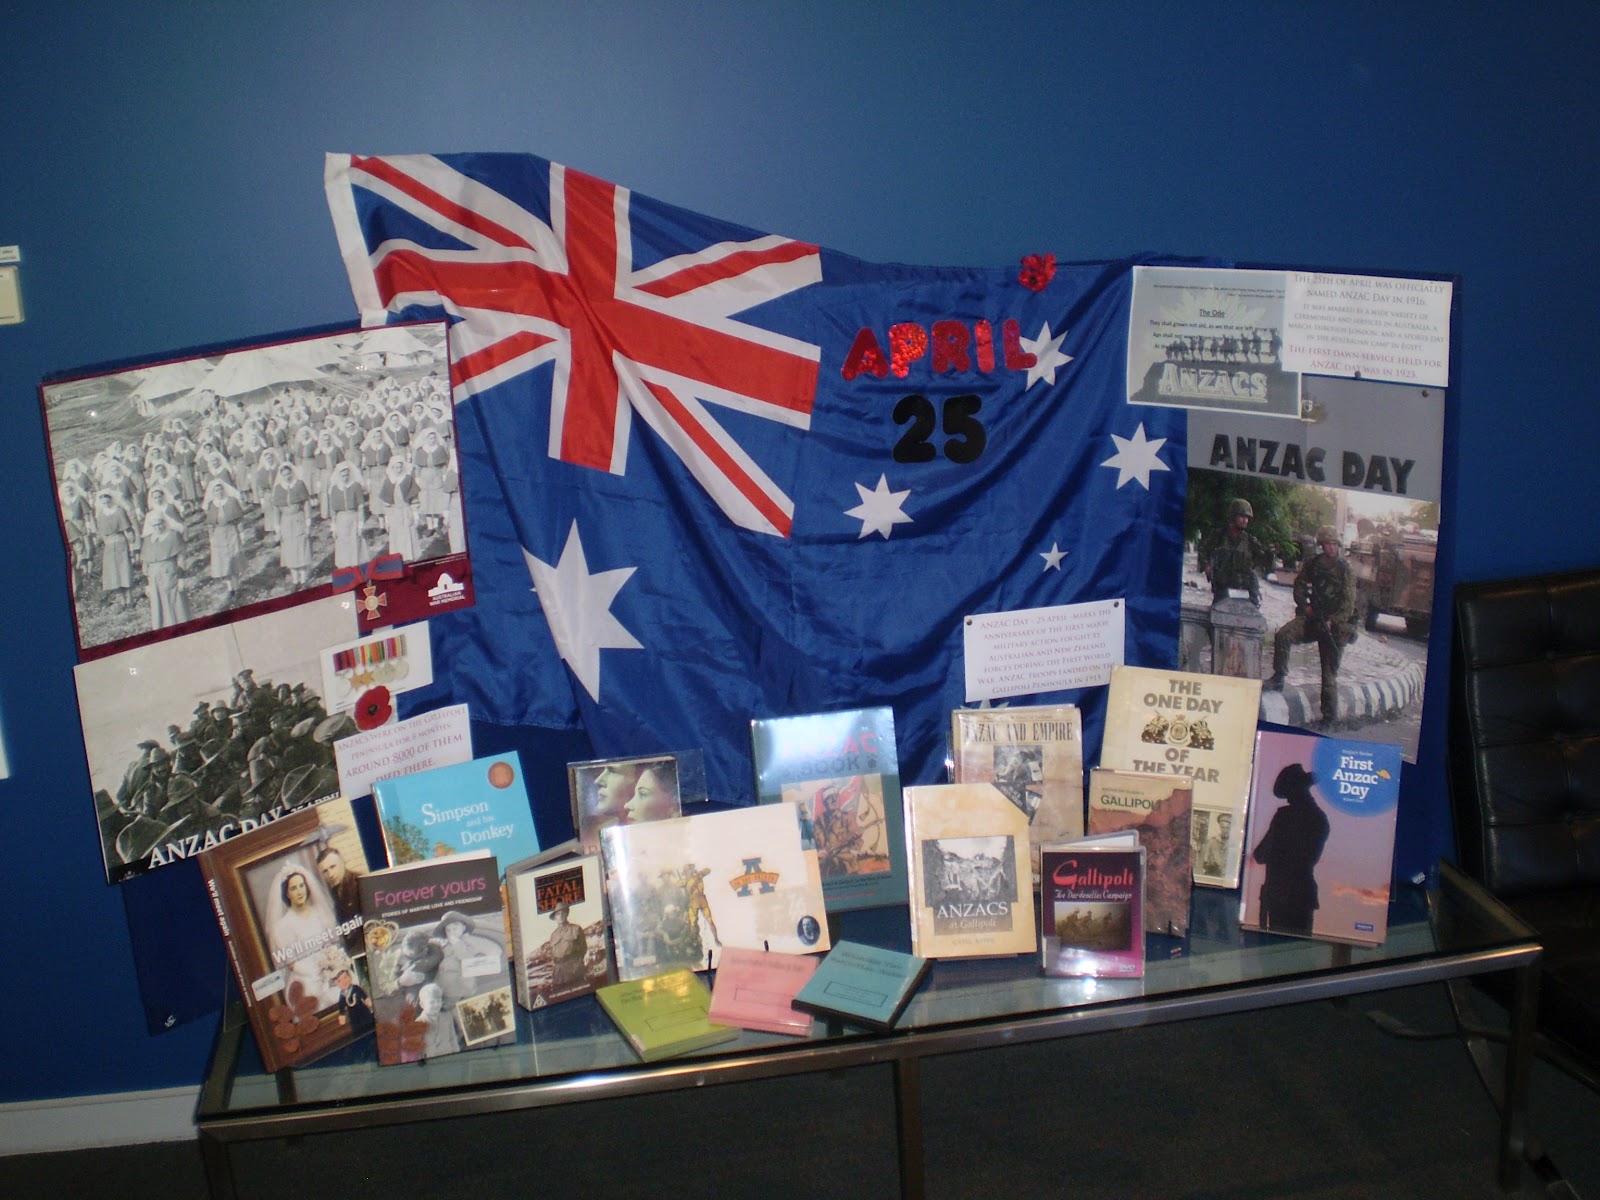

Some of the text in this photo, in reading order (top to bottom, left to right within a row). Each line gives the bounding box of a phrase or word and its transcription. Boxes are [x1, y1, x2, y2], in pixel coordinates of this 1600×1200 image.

[1294, 274, 1444, 292] THE 25TH OF APRIL WAS OFFICIALLY
[1306, 289, 1336, 298] NAMED
[1339, 291, 1369, 300] ANZAC
[1372, 294, 1390, 302] DAY
[840, 318, 1038, 381] APRIL
[1330, 337, 1368, 345] AUSTRALIAN
[1288, 344, 1442, 368] THE FIRST DAWN SERVICE HELD FOR
[1310, 360, 1341, 370] ANZAC
[1344, 363, 1360, 372] DAY
[1363, 365, 1380, 374] WAS
[1383, 367, 1392, 375] IN
[1158, 363, 1268, 399] ANZACS
[892, 393, 987, 464] 25
[1210, 434, 1416, 495] ANZAC DAY
[980, 620, 1009, 629] ANZAC
[1073, 610, 1096, 618] MARKS
[983, 629, 1034, 640] ANNIVERSARY
[992, 640, 1027, 650] MILITARY
[1030, 637, 1057, 646] ACTION
[1060, 633, 1090, 642] FOUGHT
[989, 650, 1034, 662] AUSTRALIAN
[1054, 646, 1071, 654] NEW
[1073, 642, 1105, 652] ZEALAND
[984, 664, 1010, 673] FORCES
[1014, 660, 1044, 670] DURING
[1061, 655, 1081, 664] FIRST
[1083, 652, 1110, 661] WORLD
[998, 672, 1025, 682] ANZAC
[1028, 669, 1056, 678] TROOPS
[1058, 665, 1087, 675] LANDED
[992, 683, 1029, 694] GALLIPOLI
[1032, 678, 1072, 688] PENINSULA
[1168, 679, 1202, 696] THE
[1143, 692, 1224, 714] ONE DAY
[337, 736, 369, 750] ANZACS
[369, 728, 392, 739] WERE
[408, 719, 422, 727] THE
[1033, 722, 1073, 741] EMPIRE
[345, 733, 462, 777] AROUND 8000 OF THEM
[350, 741, 393, 759] PENINSULA
[395, 736, 409, 744] FOR
[1165, 748, 1190, 763] OF
[1133, 759, 1220, 784] THE YEAR
[1341, 755, 1374, 772] First
[1332, 768, 1379, 785] Anzac
[1339, 782, 1370, 799] Day
[1100, 795, 1162, 811] GALLIPOLI
[421, 801, 489, 827] Simpson
[147, 805, 286, 870] ANZAC DAY
[461, 823, 515, 846] Donkey
[1053, 859, 1134, 890] Gallipoli
[374, 876, 487, 908] Forever yours
[537, 880, 581, 900] FATAL
[1055, 889, 1066, 899] The
[1102, 889, 1133, 902] Campaign
[936, 901, 1009, 919] ANZACS
[960, 918, 997, 930] Gallipoli
[272, 941, 303, 964] We'll
[304, 927, 335, 950] meet
